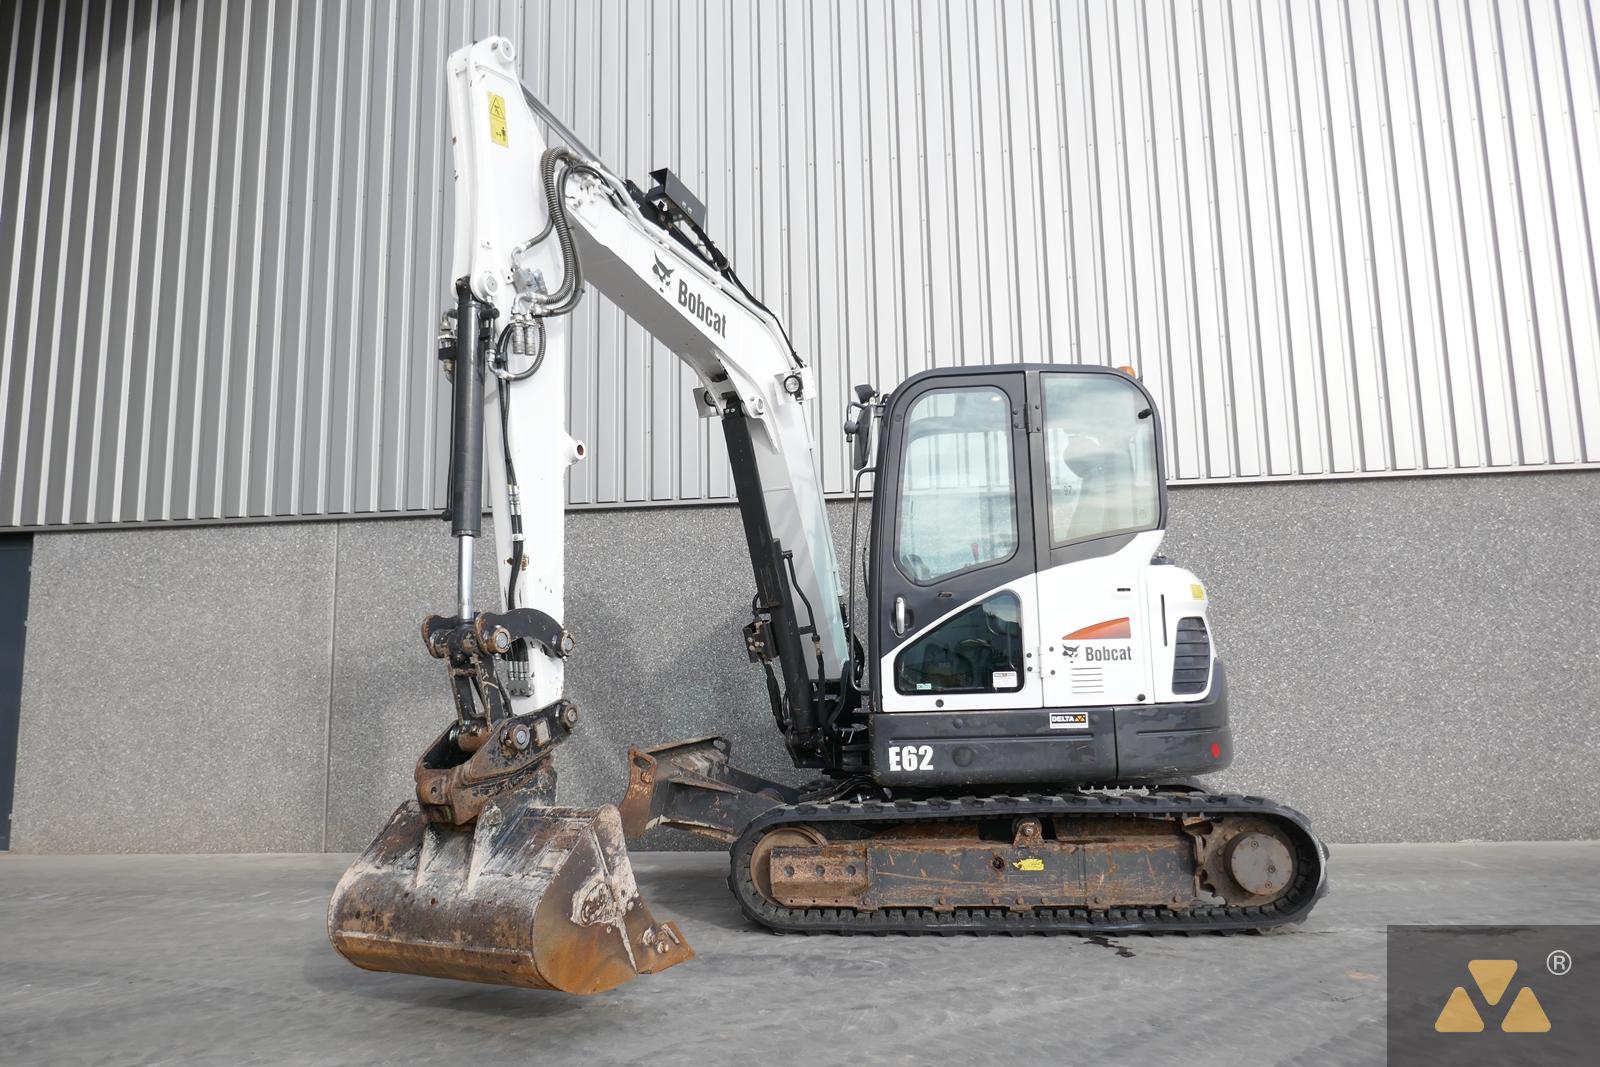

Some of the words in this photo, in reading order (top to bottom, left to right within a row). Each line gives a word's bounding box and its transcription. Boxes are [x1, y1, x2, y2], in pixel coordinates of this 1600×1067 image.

[677, 278, 726, 339] Bobcat
[1085, 646, 1132, 661] Bobcat
[1051, 715, 1075, 723] DELTA
[888, 745, 934, 771] E62
